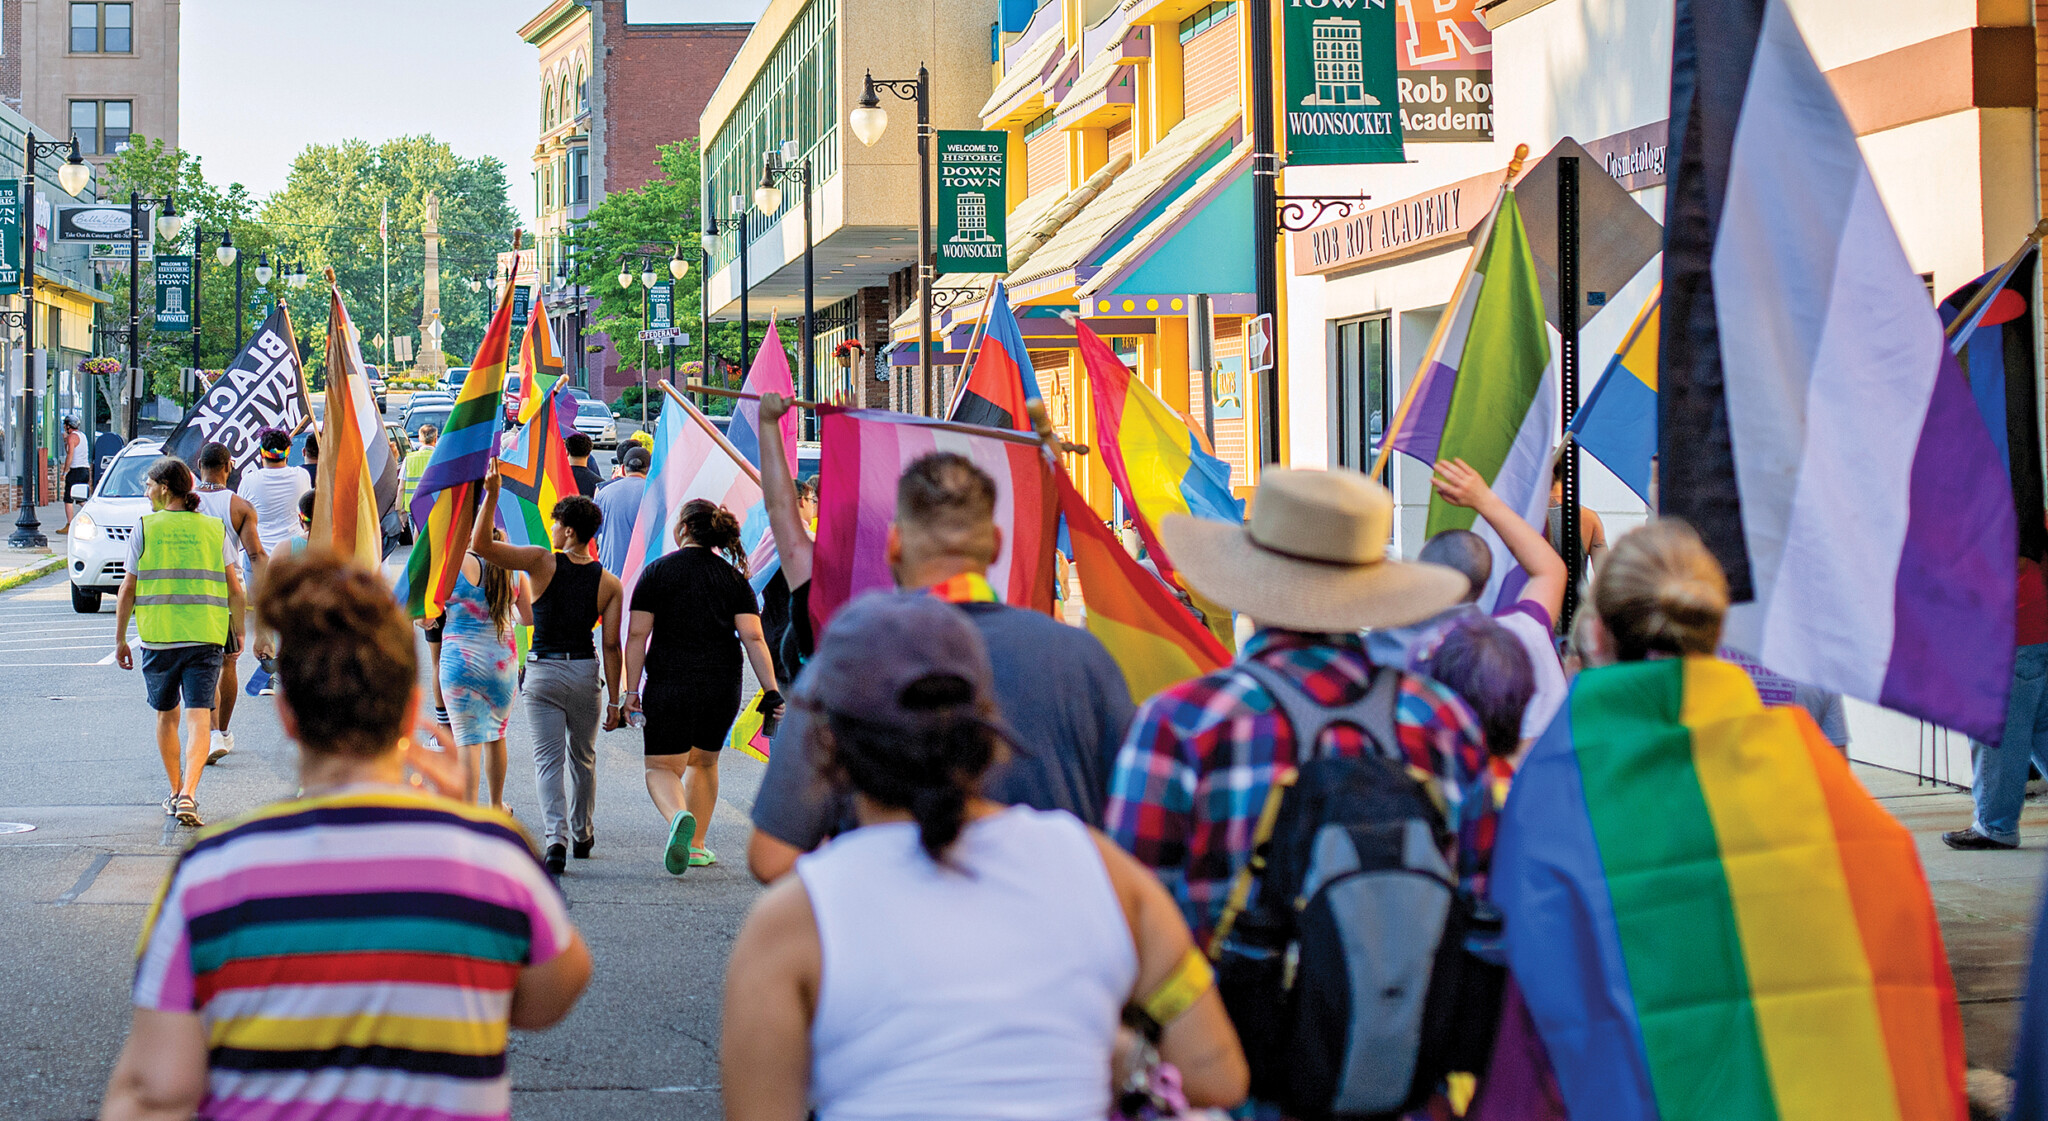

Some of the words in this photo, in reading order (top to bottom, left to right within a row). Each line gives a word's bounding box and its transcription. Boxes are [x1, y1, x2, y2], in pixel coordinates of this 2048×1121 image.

[1397, 75, 1448, 104] Rob
[1289, 112, 1393, 136] WOONSOCKET
[947, 144, 986, 152] WELCOME
[988, 144, 999, 152] TO
[943, 154, 1002, 162] HISTORIC
[1605, 142, 1668, 178] Cosmetology
[943, 166, 1002, 176] DOWN
[942, 178, 1001, 187] TOWN
[1312, 226, 1340, 266] ROB
[1345, 214, 1373, 258] ROY
[1381, 188, 1460, 249] ACADEMY
[943, 244, 1003, 258] WOONSOCKET
[157, 314, 189, 323] WOONSOCKET
[646, 329, 674, 339] FEDERAL
